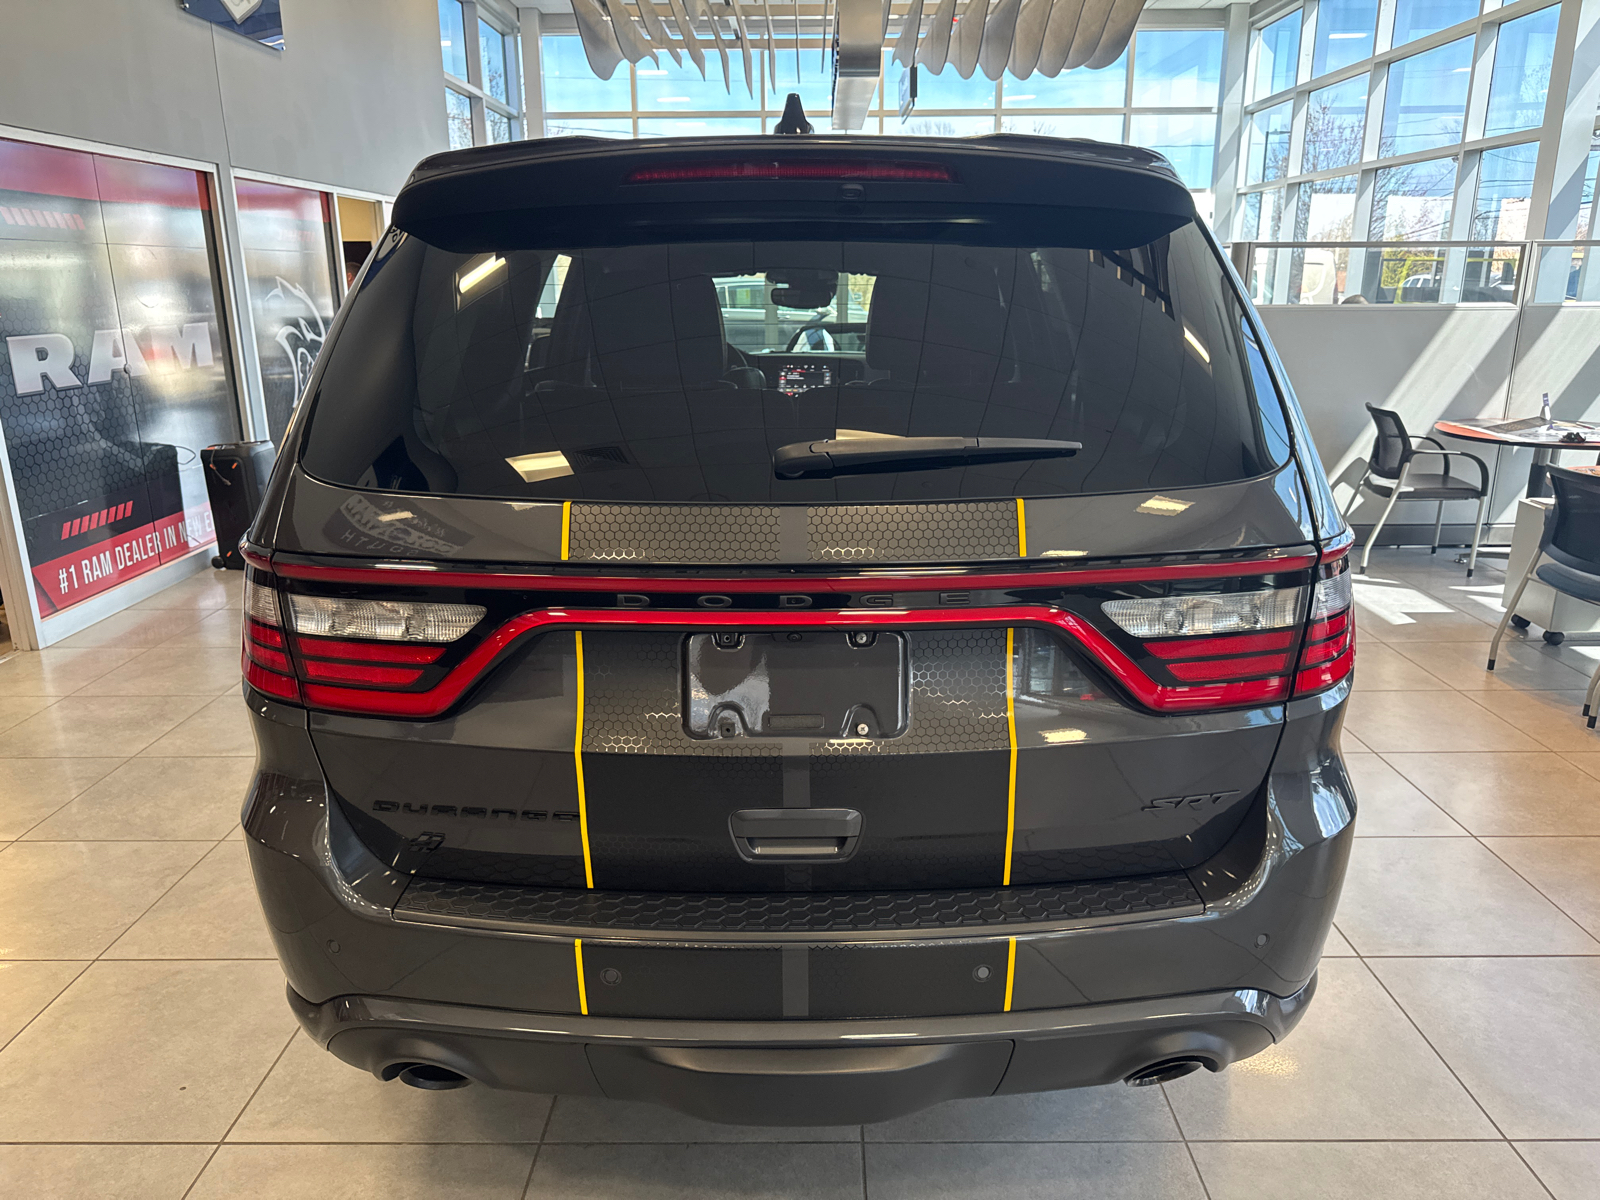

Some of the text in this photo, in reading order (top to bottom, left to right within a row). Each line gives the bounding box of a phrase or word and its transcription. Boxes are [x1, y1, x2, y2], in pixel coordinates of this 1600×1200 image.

[6, 322, 214, 397] RAM
[58, 564, 79, 594] #1
[81, 550, 114, 584] RAM
[115, 531, 163, 570] DEALER
[164, 525, 177, 549] IN
[178, 514, 203, 544] NEW
[616, 591, 972, 608] DODGE
[372, 800, 581, 822] DURANGO
[1141, 789, 1241, 812] SRT
